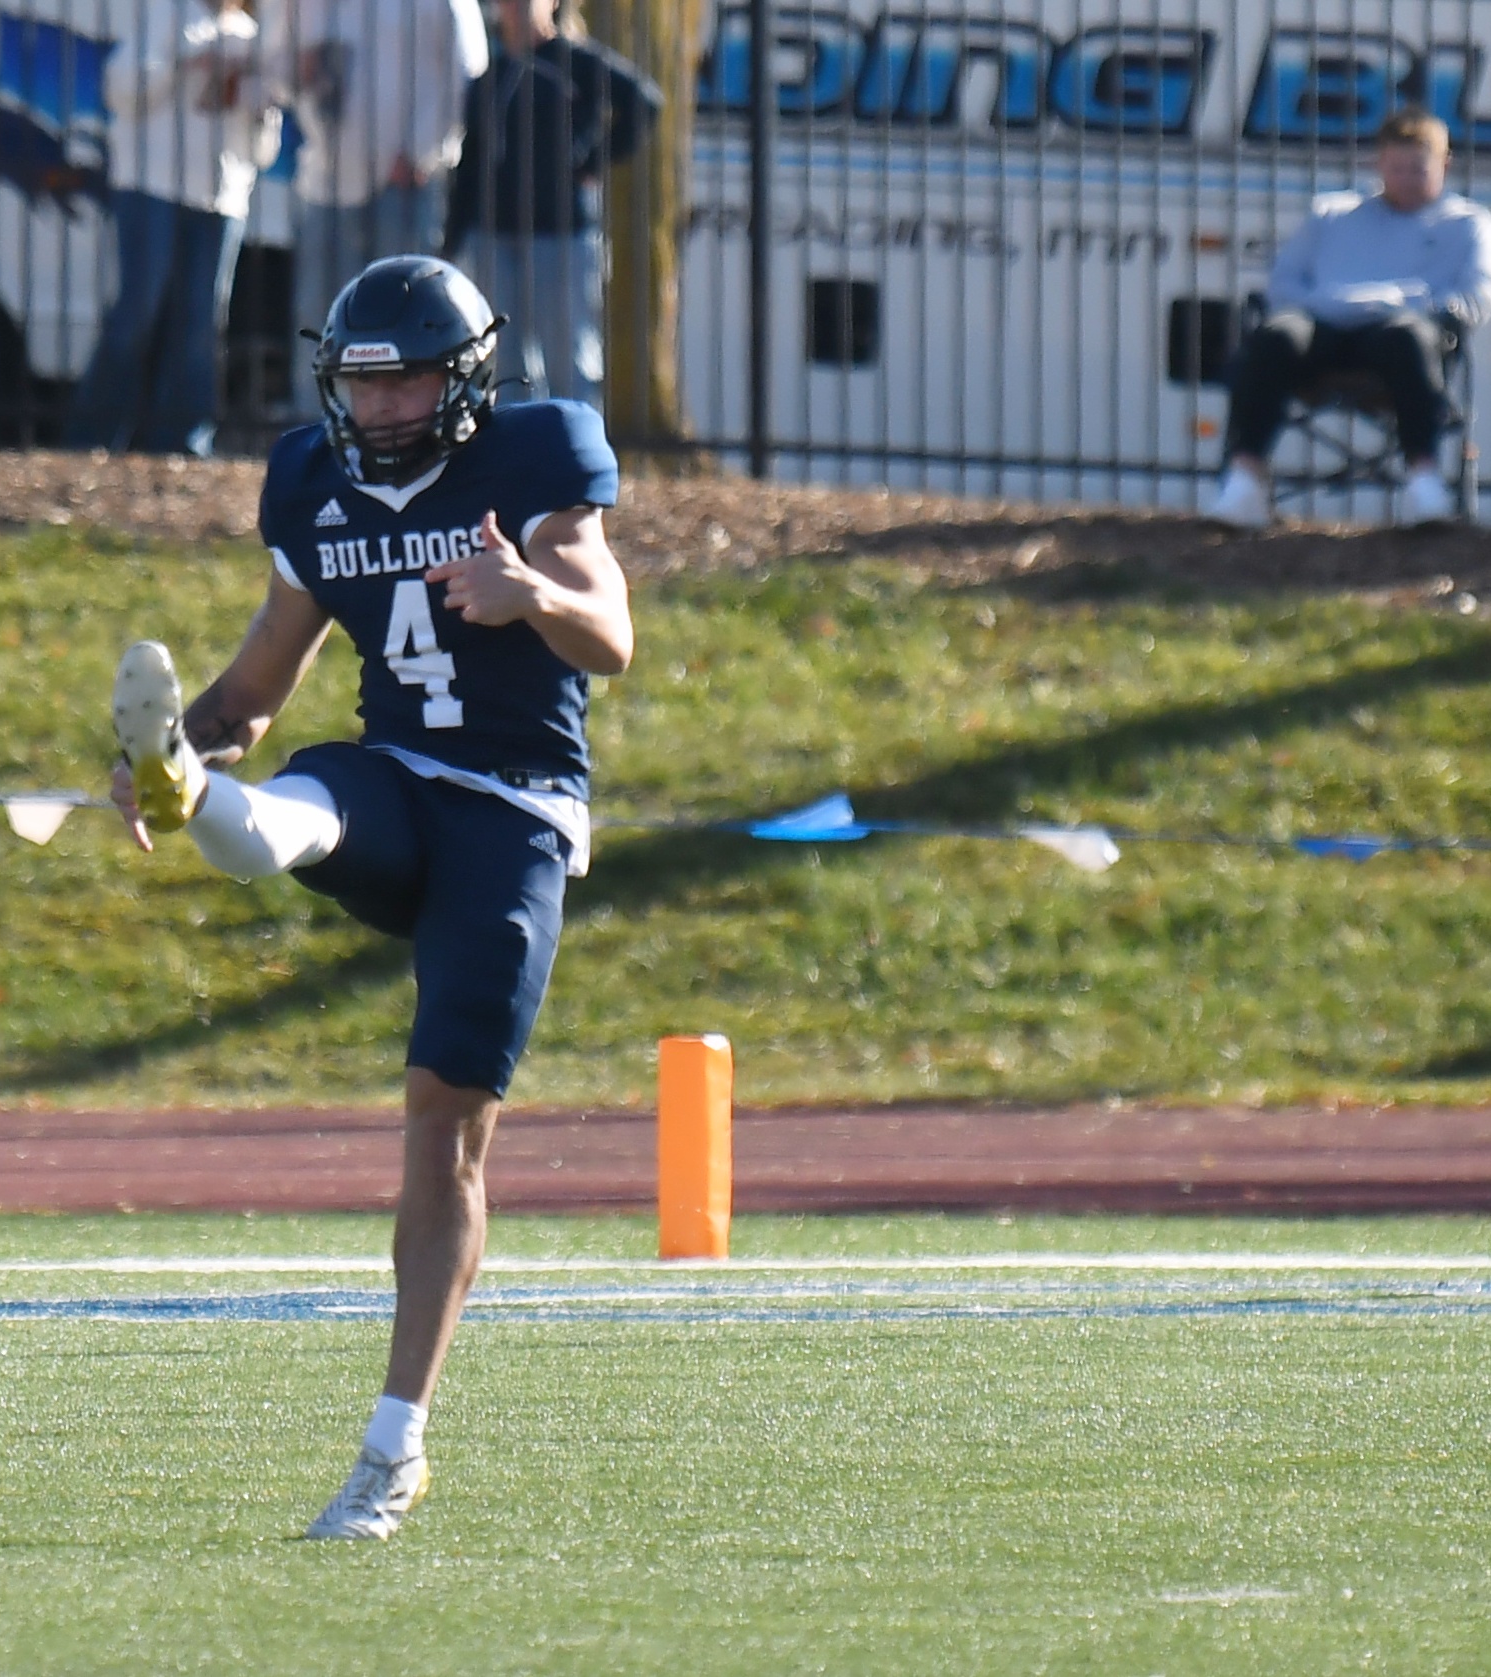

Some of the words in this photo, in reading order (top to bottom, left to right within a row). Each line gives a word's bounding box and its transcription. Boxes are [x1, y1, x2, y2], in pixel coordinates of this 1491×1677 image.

[347, 347, 390, 359] Riddell
[317, 525, 488, 580] BULLDOGS
[384, 579, 463, 728] 4
